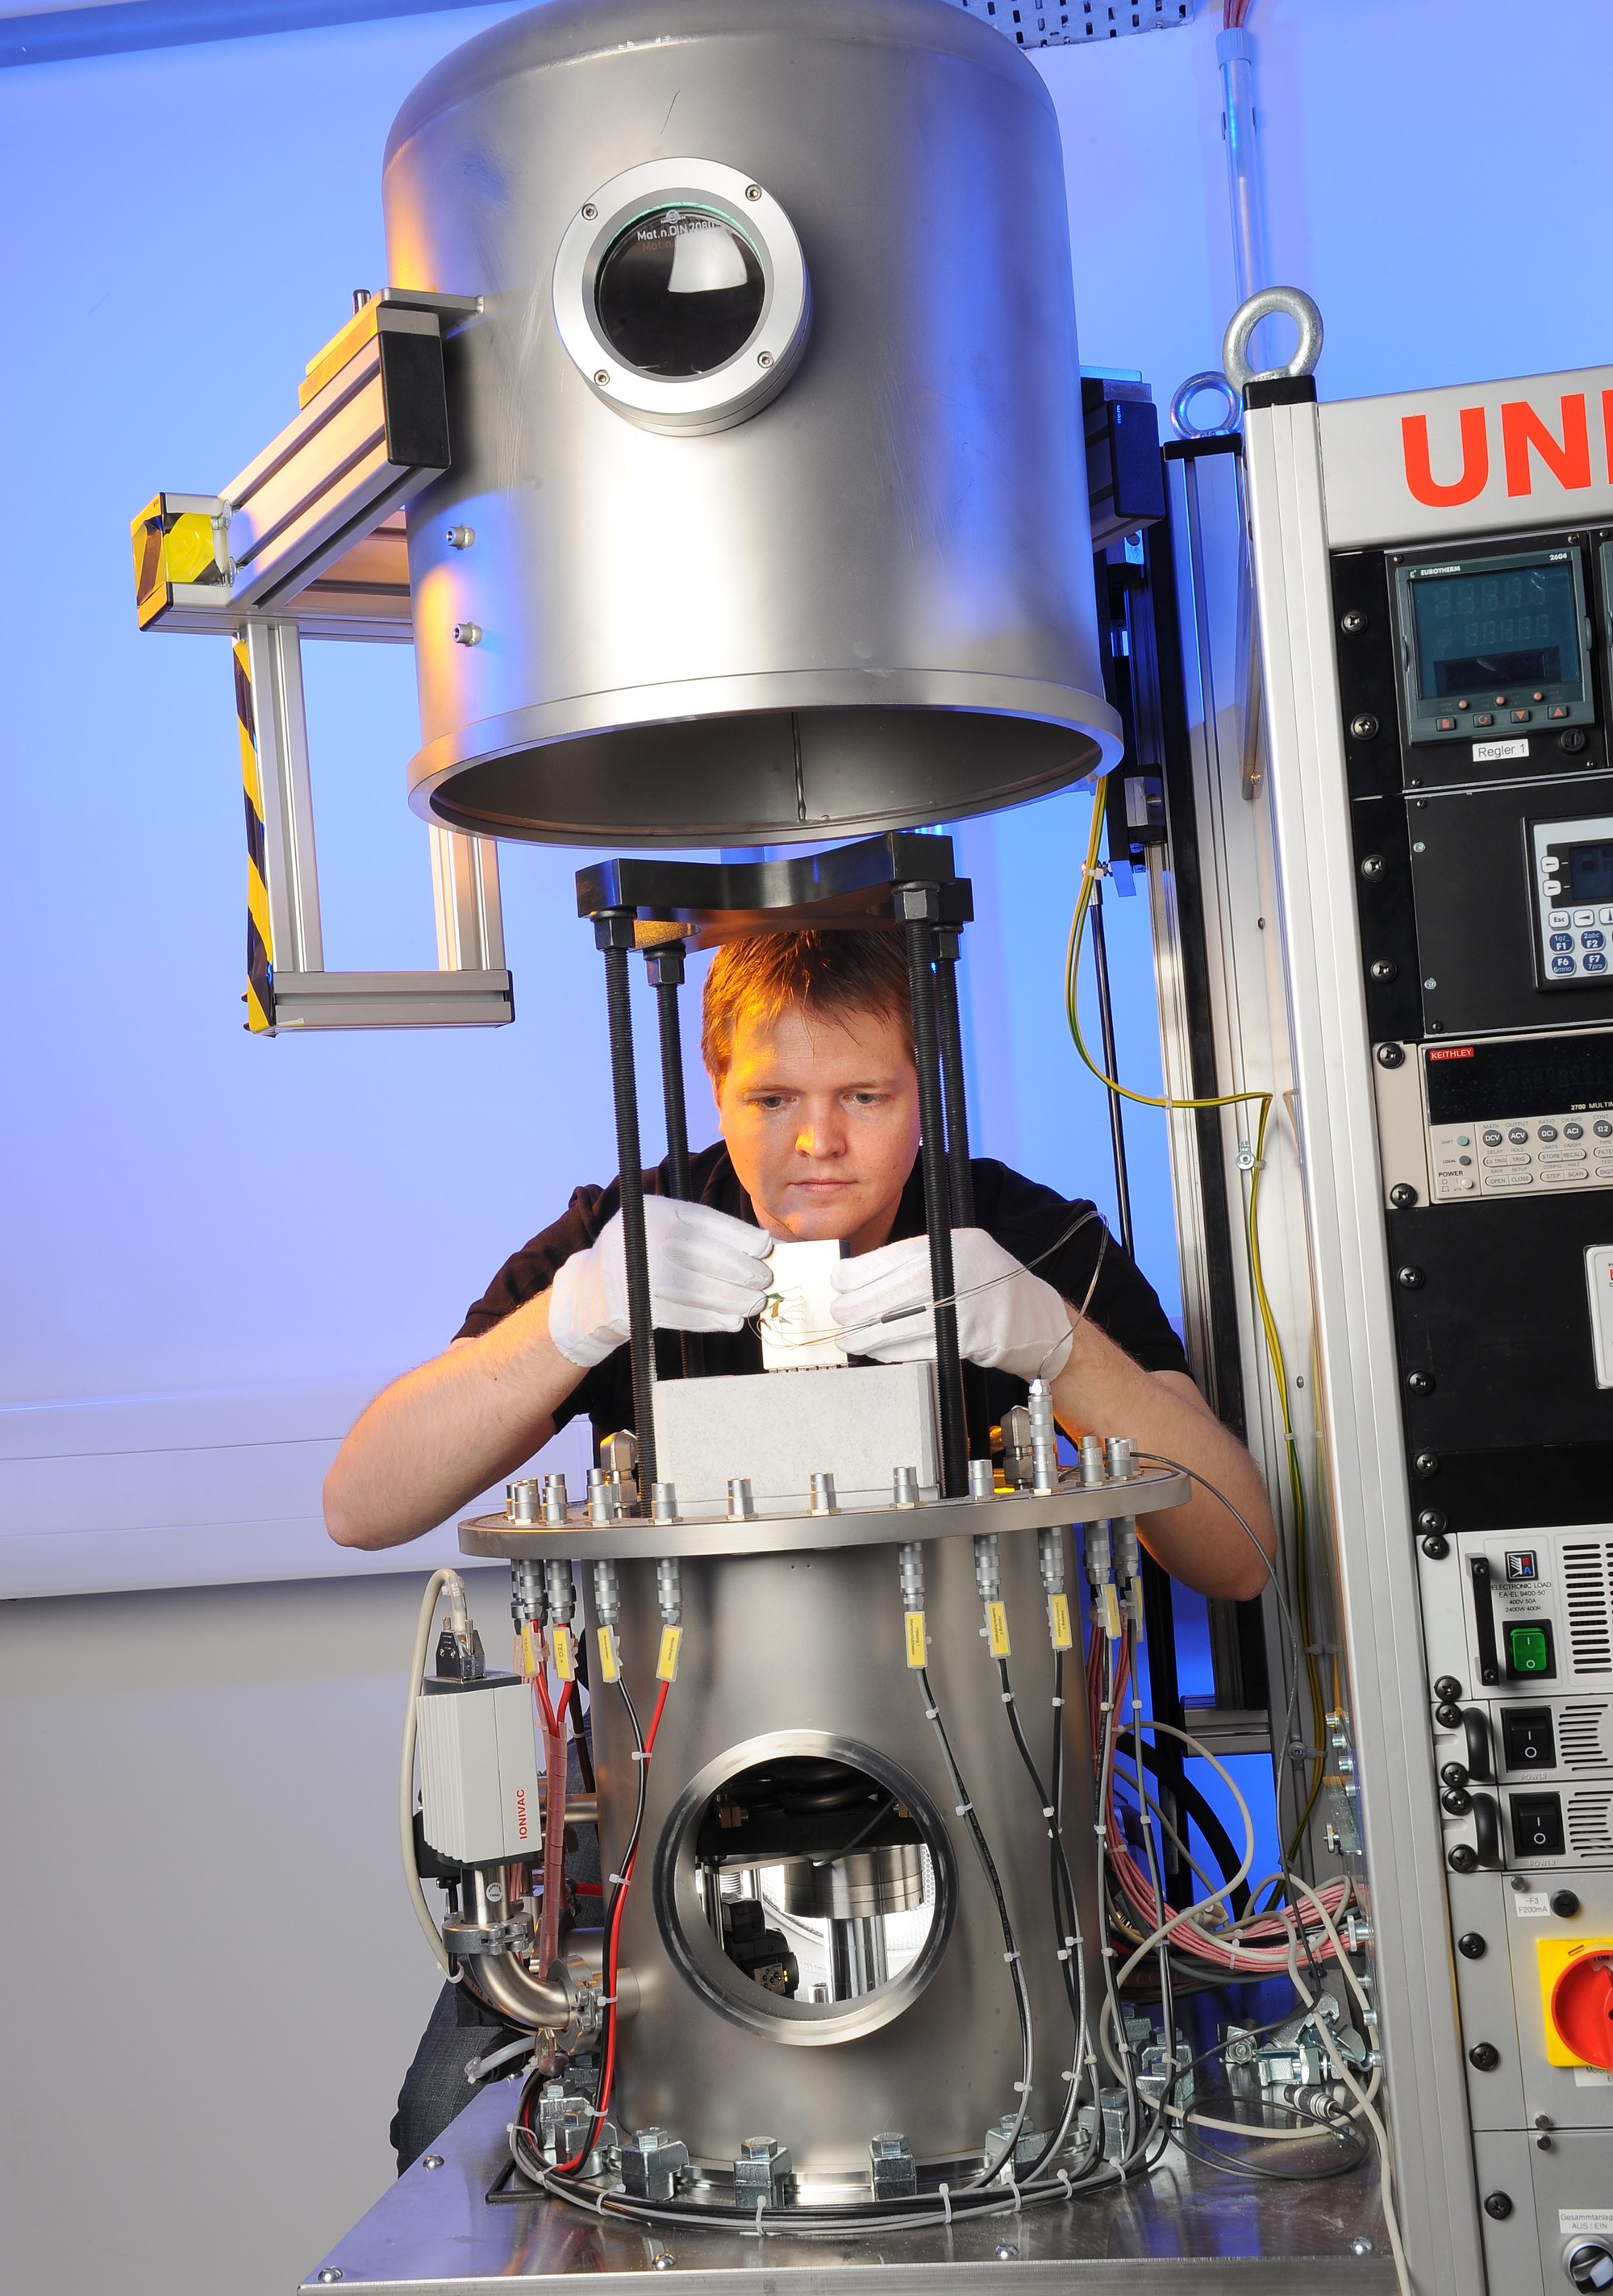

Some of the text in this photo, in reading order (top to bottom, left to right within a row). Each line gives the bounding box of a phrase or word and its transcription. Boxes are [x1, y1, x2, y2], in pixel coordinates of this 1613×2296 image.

[1549, 552, 1568, 561] 2604
[1420, 565, 1461, 577] EUROTHERM
[1478, 744, 1526, 759] Regler 1
[1556, 942, 1567, 950] F1
[1586, 940, 1598, 948] F2
[1557, 958, 1569, 966] F6
[1589, 955, 1601, 963] F7
[1431, 1048, 1473, 1060] KEITHLEY
[1485, 1134, 1500, 1142] DCV
[1491, 1582, 1532, 1591] ELECTRONIC
[516, 1789, 528, 1840] IONIVAC
[1519, 1906, 1548, 1914] F200mA
[1572, 2222, 1588, 2230] AUS
